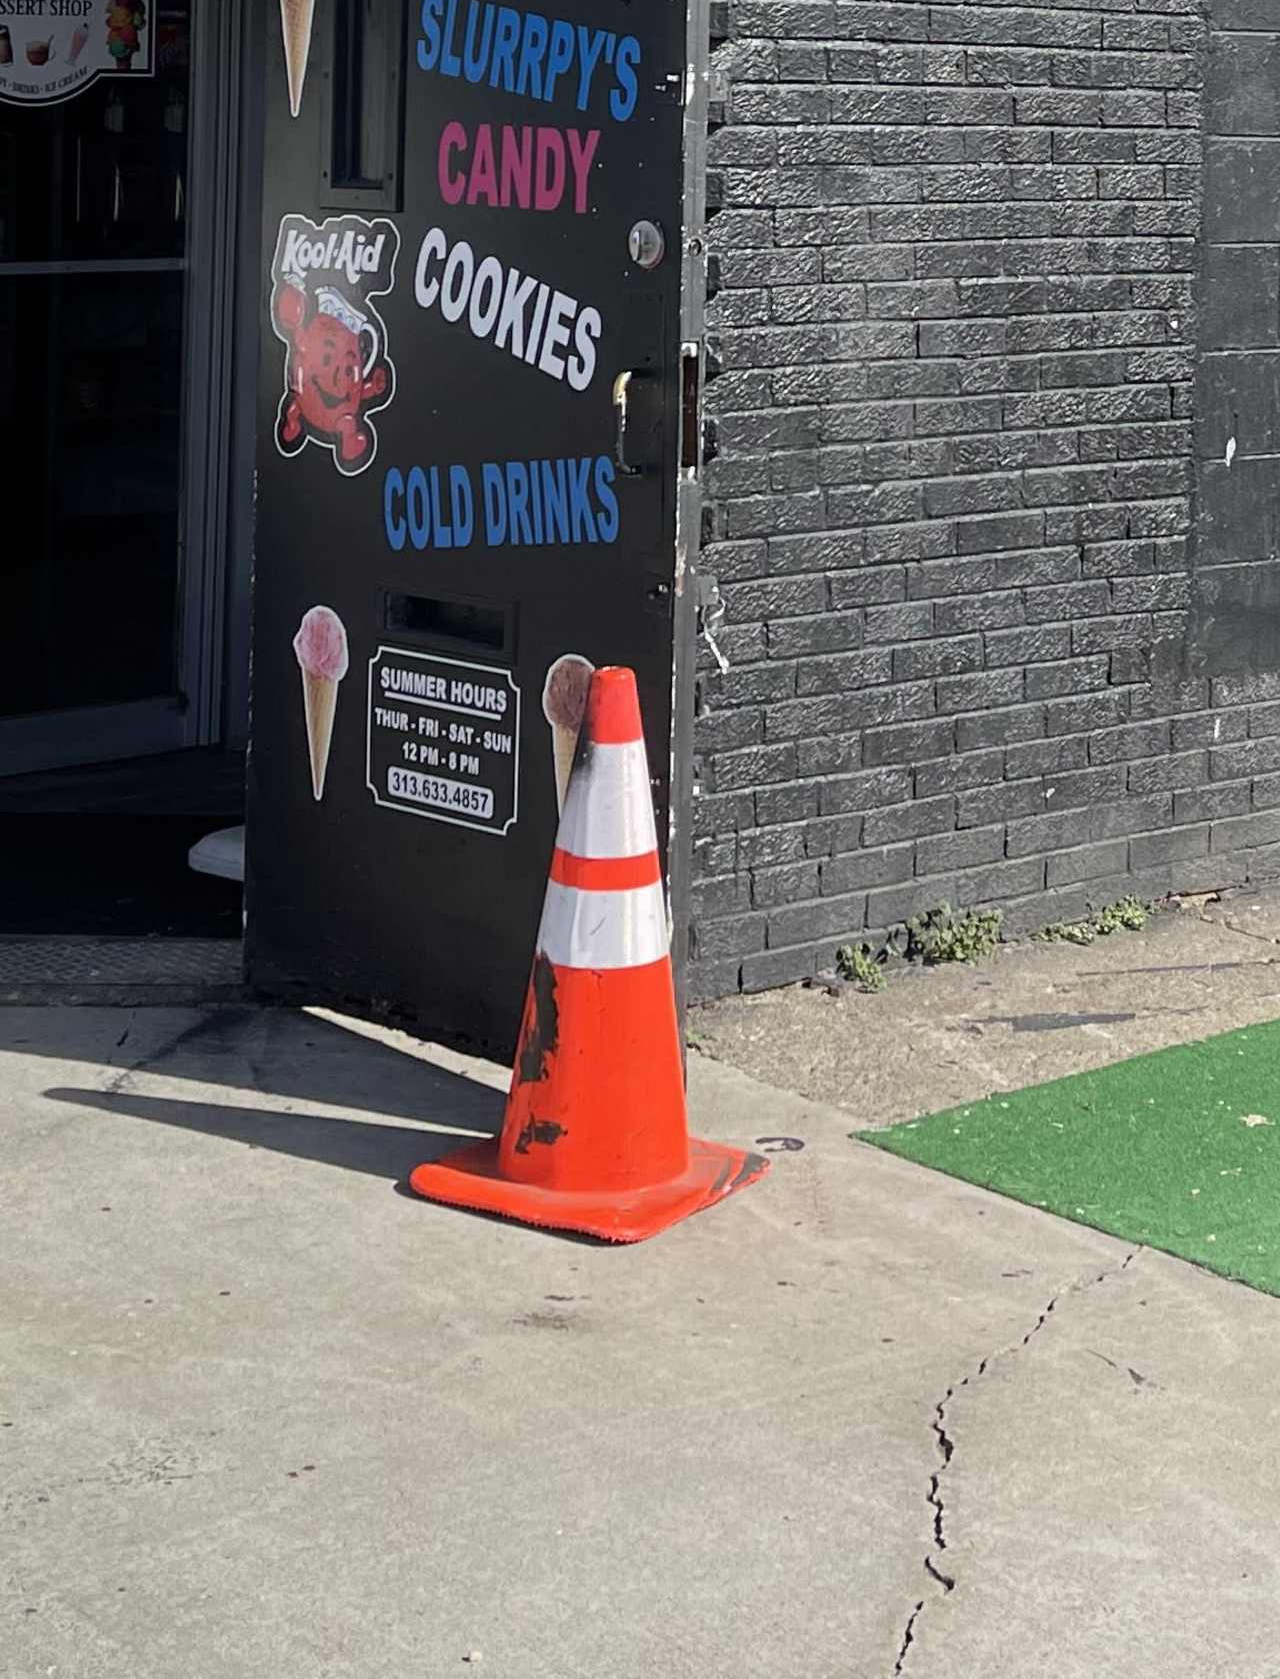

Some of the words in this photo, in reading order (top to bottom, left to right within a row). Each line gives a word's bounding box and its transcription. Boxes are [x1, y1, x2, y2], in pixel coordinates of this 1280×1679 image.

[50, 0, 93, 17] SHOP
[438, 121, 600, 213] CANDY
[281, 229, 386, 284] Kool-Aid
[414, 226, 602, 392] COOKIES
[383, 464, 474, 552] COLD
[482, 454, 620, 547] DRINKS
[380, 666, 447, 702] SUMMER
[451, 681, 507, 713] HOURS
[374, 707, 409, 732] THUR
[418, 716, 439, 738] FRI
[449, 723, 474, 745] SAT
[483, 731, 512, 754] SUN
[402, 742, 418, 761] 12
[419, 745, 439, 765] PM
[448, 752, 458, 771] 8
[460, 755, 480, 776] PM
[392, 772, 489, 812] 313.633.4857
